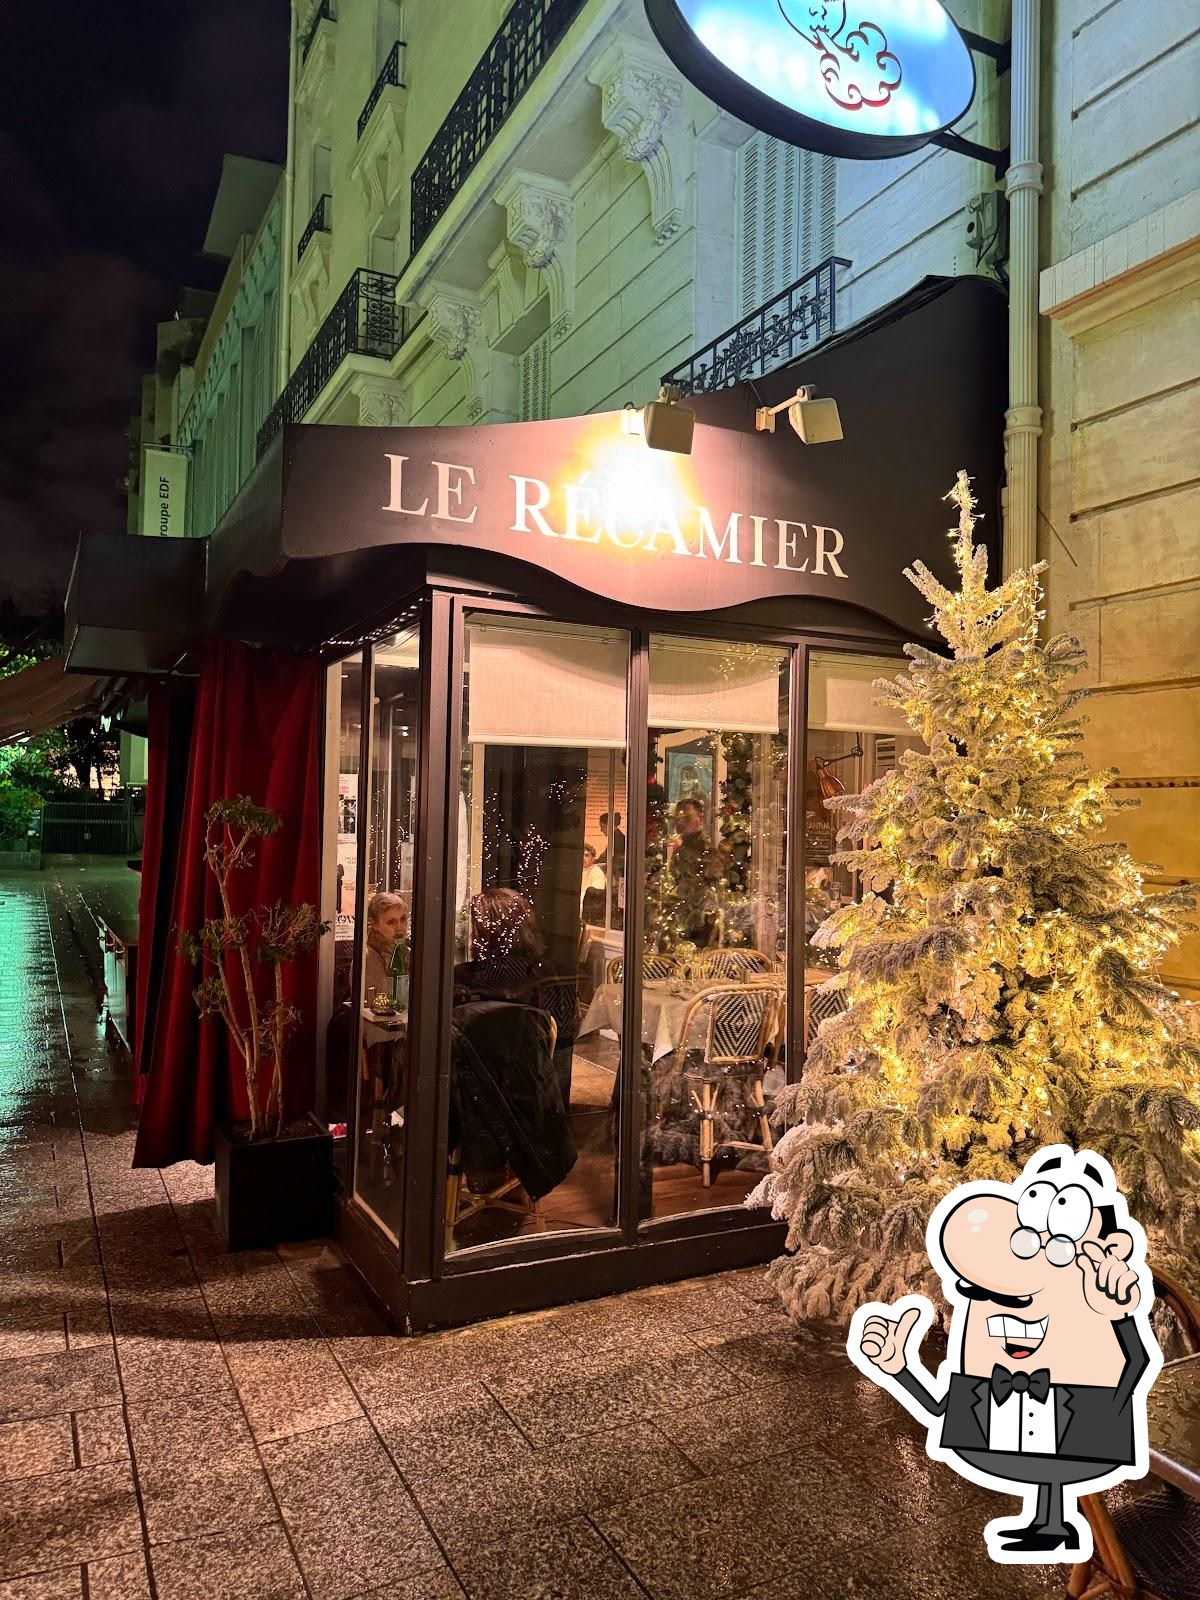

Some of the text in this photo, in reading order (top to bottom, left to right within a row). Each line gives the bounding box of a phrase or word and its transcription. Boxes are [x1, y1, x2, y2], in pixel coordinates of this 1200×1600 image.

[159, 476, 171, 536] roupe EDF
[382, 453, 477, 524] LE
